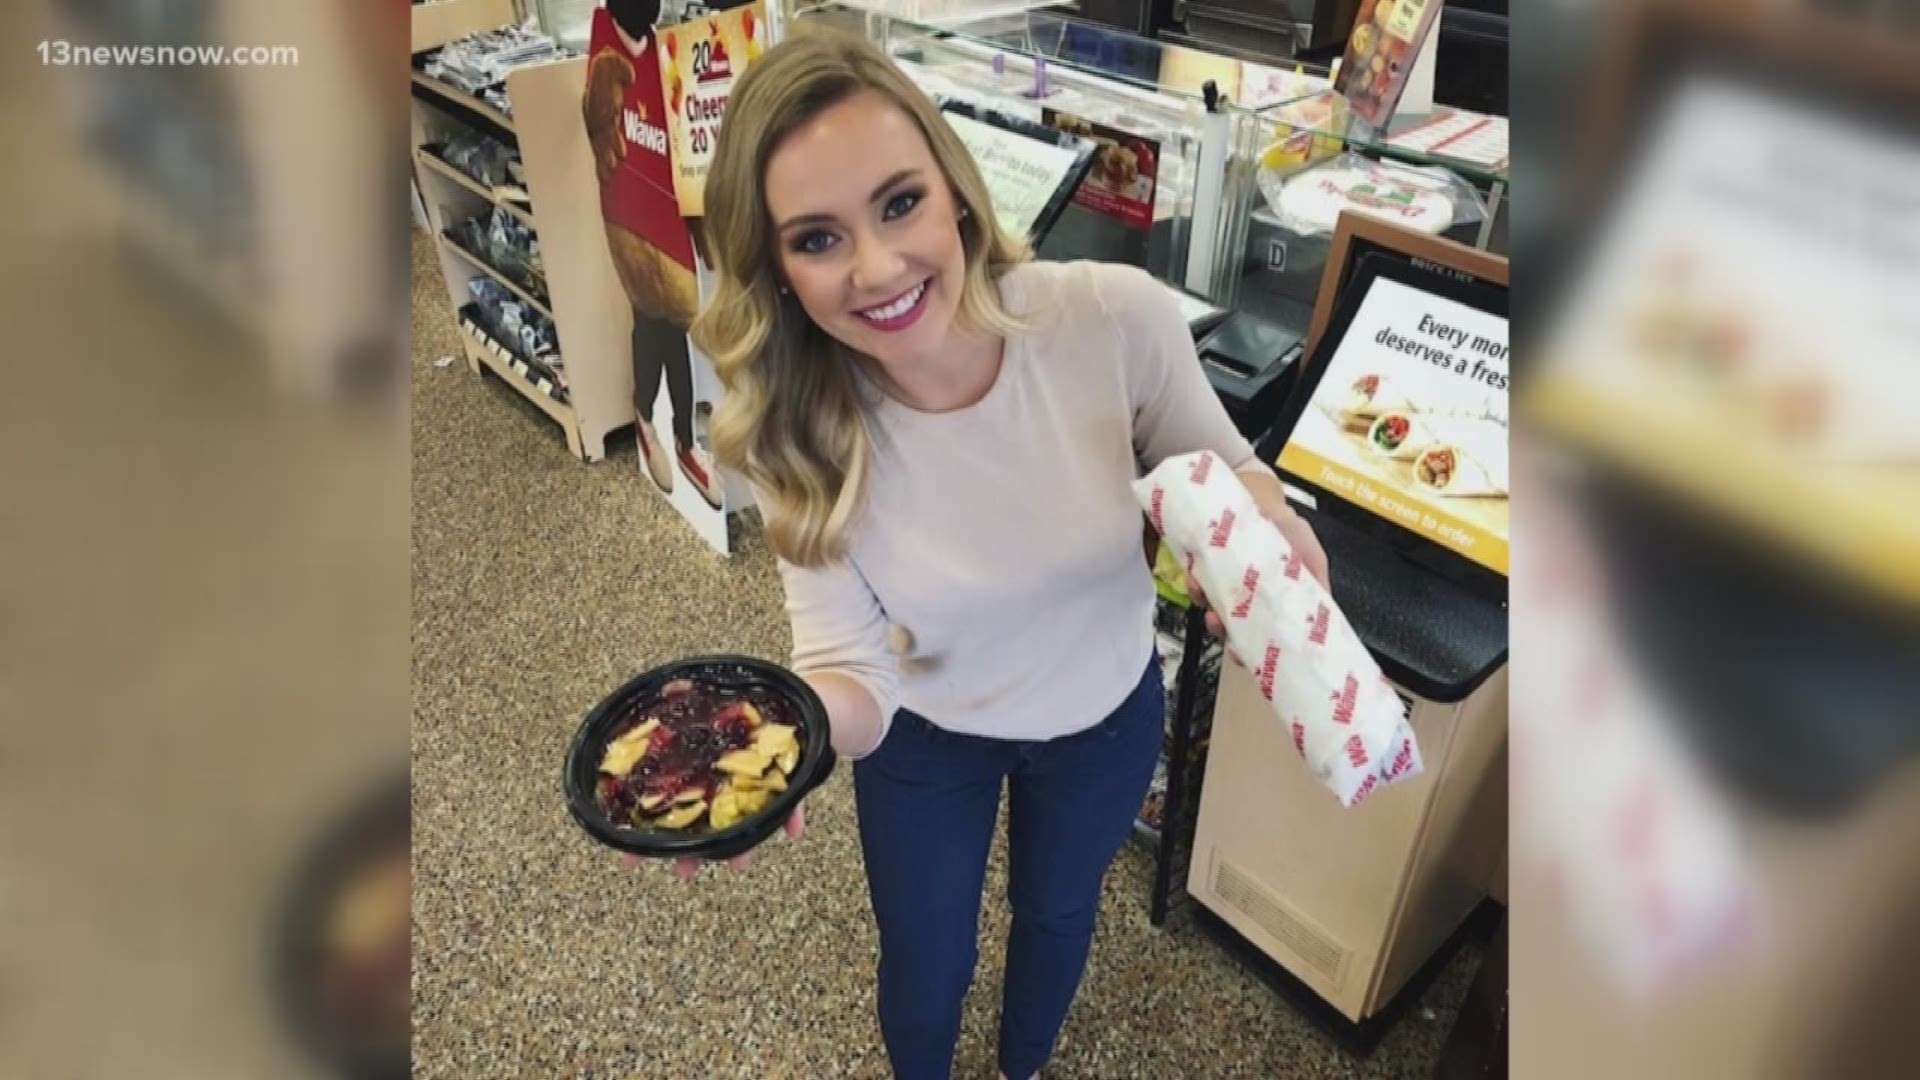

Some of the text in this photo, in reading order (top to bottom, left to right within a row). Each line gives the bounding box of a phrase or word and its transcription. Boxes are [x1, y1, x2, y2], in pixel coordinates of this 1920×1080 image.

[692, 38, 711, 75] 20
[624, 109, 667, 156] Wawa
[690, 127, 708, 154] 20
[1271, 244, 1284, 266] D
[1375, 326, 1454, 369] deserves
[1454, 358, 1468, 375] a
[1417, 313, 1469, 349] Every
[1209, 508, 1237, 548] Wawa
[1320, 466, 1476, 547] Touch the screen to order
[1308, 602, 1331, 645] Wawa
[1260, 645, 1280, 701] Wawa
[1332, 674, 1359, 724] Wawa
